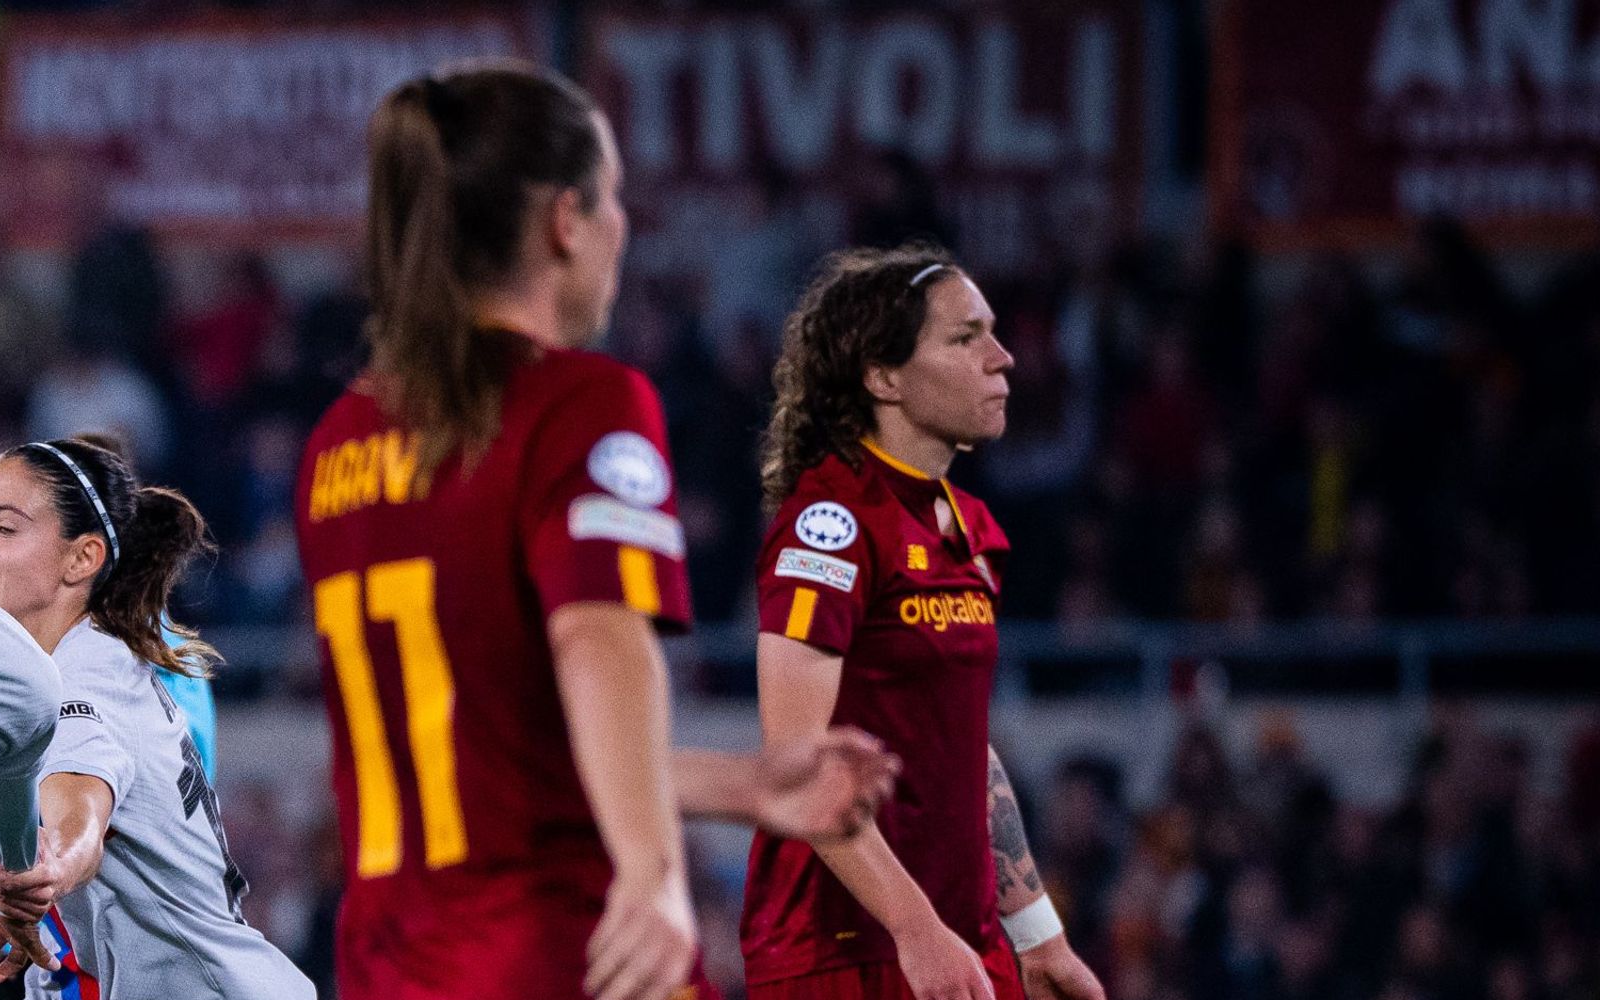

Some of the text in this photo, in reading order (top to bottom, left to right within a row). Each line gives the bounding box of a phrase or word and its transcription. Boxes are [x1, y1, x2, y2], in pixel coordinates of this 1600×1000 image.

[603, 17, 1118, 170] TIVOLI
[1370, 0, 1600, 96] AN
[314, 556, 470, 880] 11
